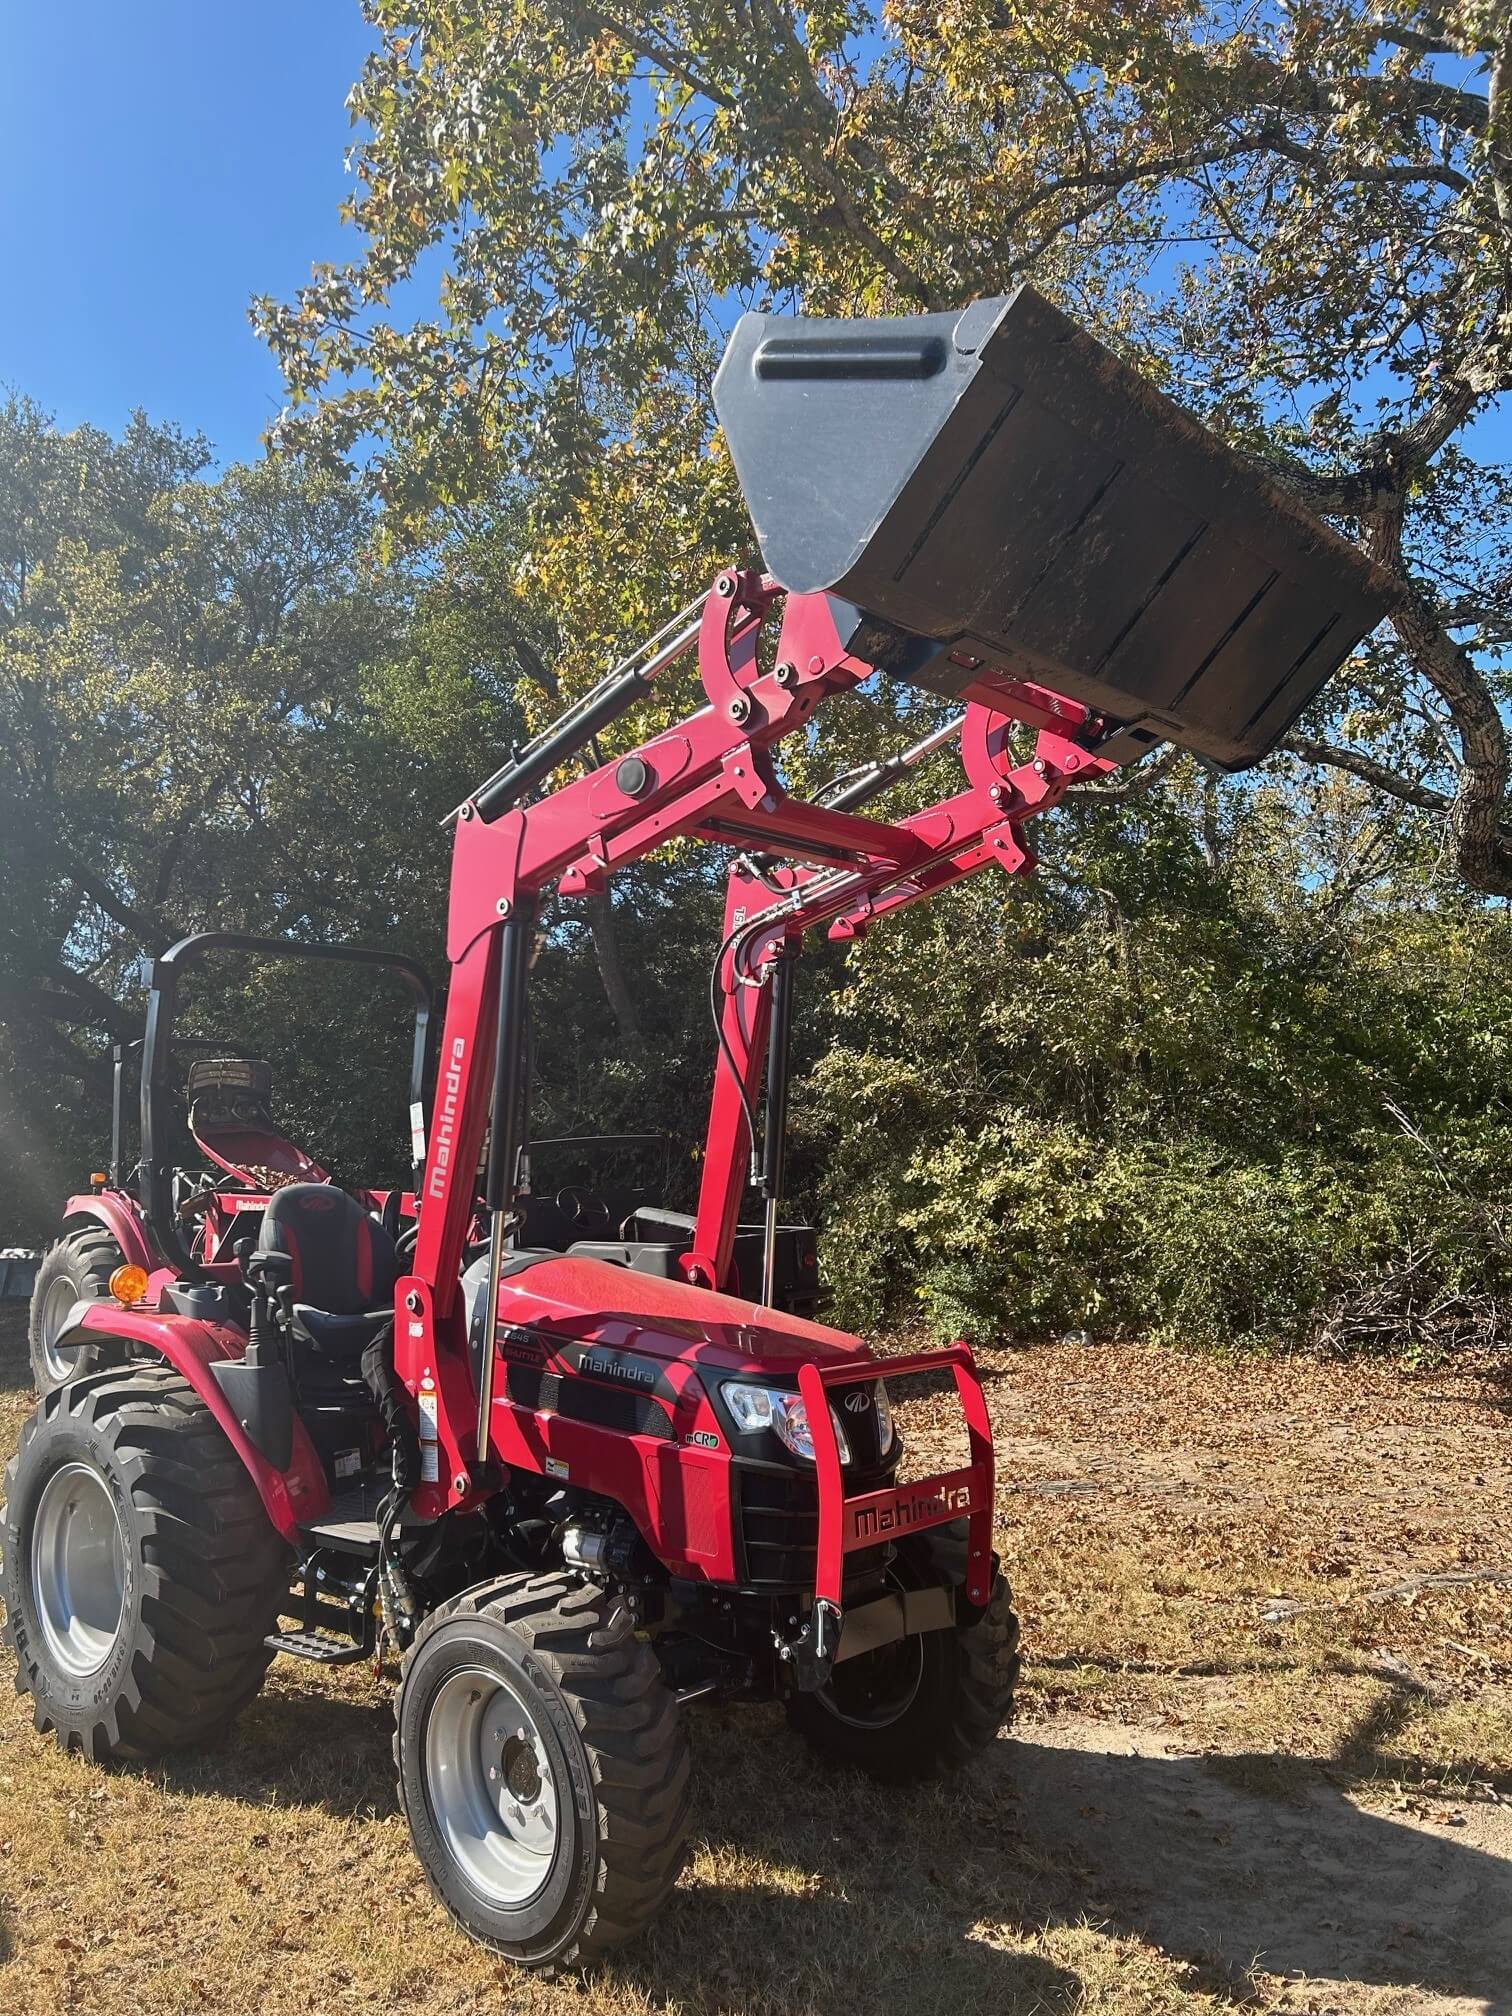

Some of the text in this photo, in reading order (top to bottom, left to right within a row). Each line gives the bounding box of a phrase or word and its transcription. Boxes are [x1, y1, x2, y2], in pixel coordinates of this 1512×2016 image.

[429, 1037, 465, 1198] Mahindra
[578, 1353, 656, 1384] Mahindra
[855, 1486, 971, 1539] Mahindra
